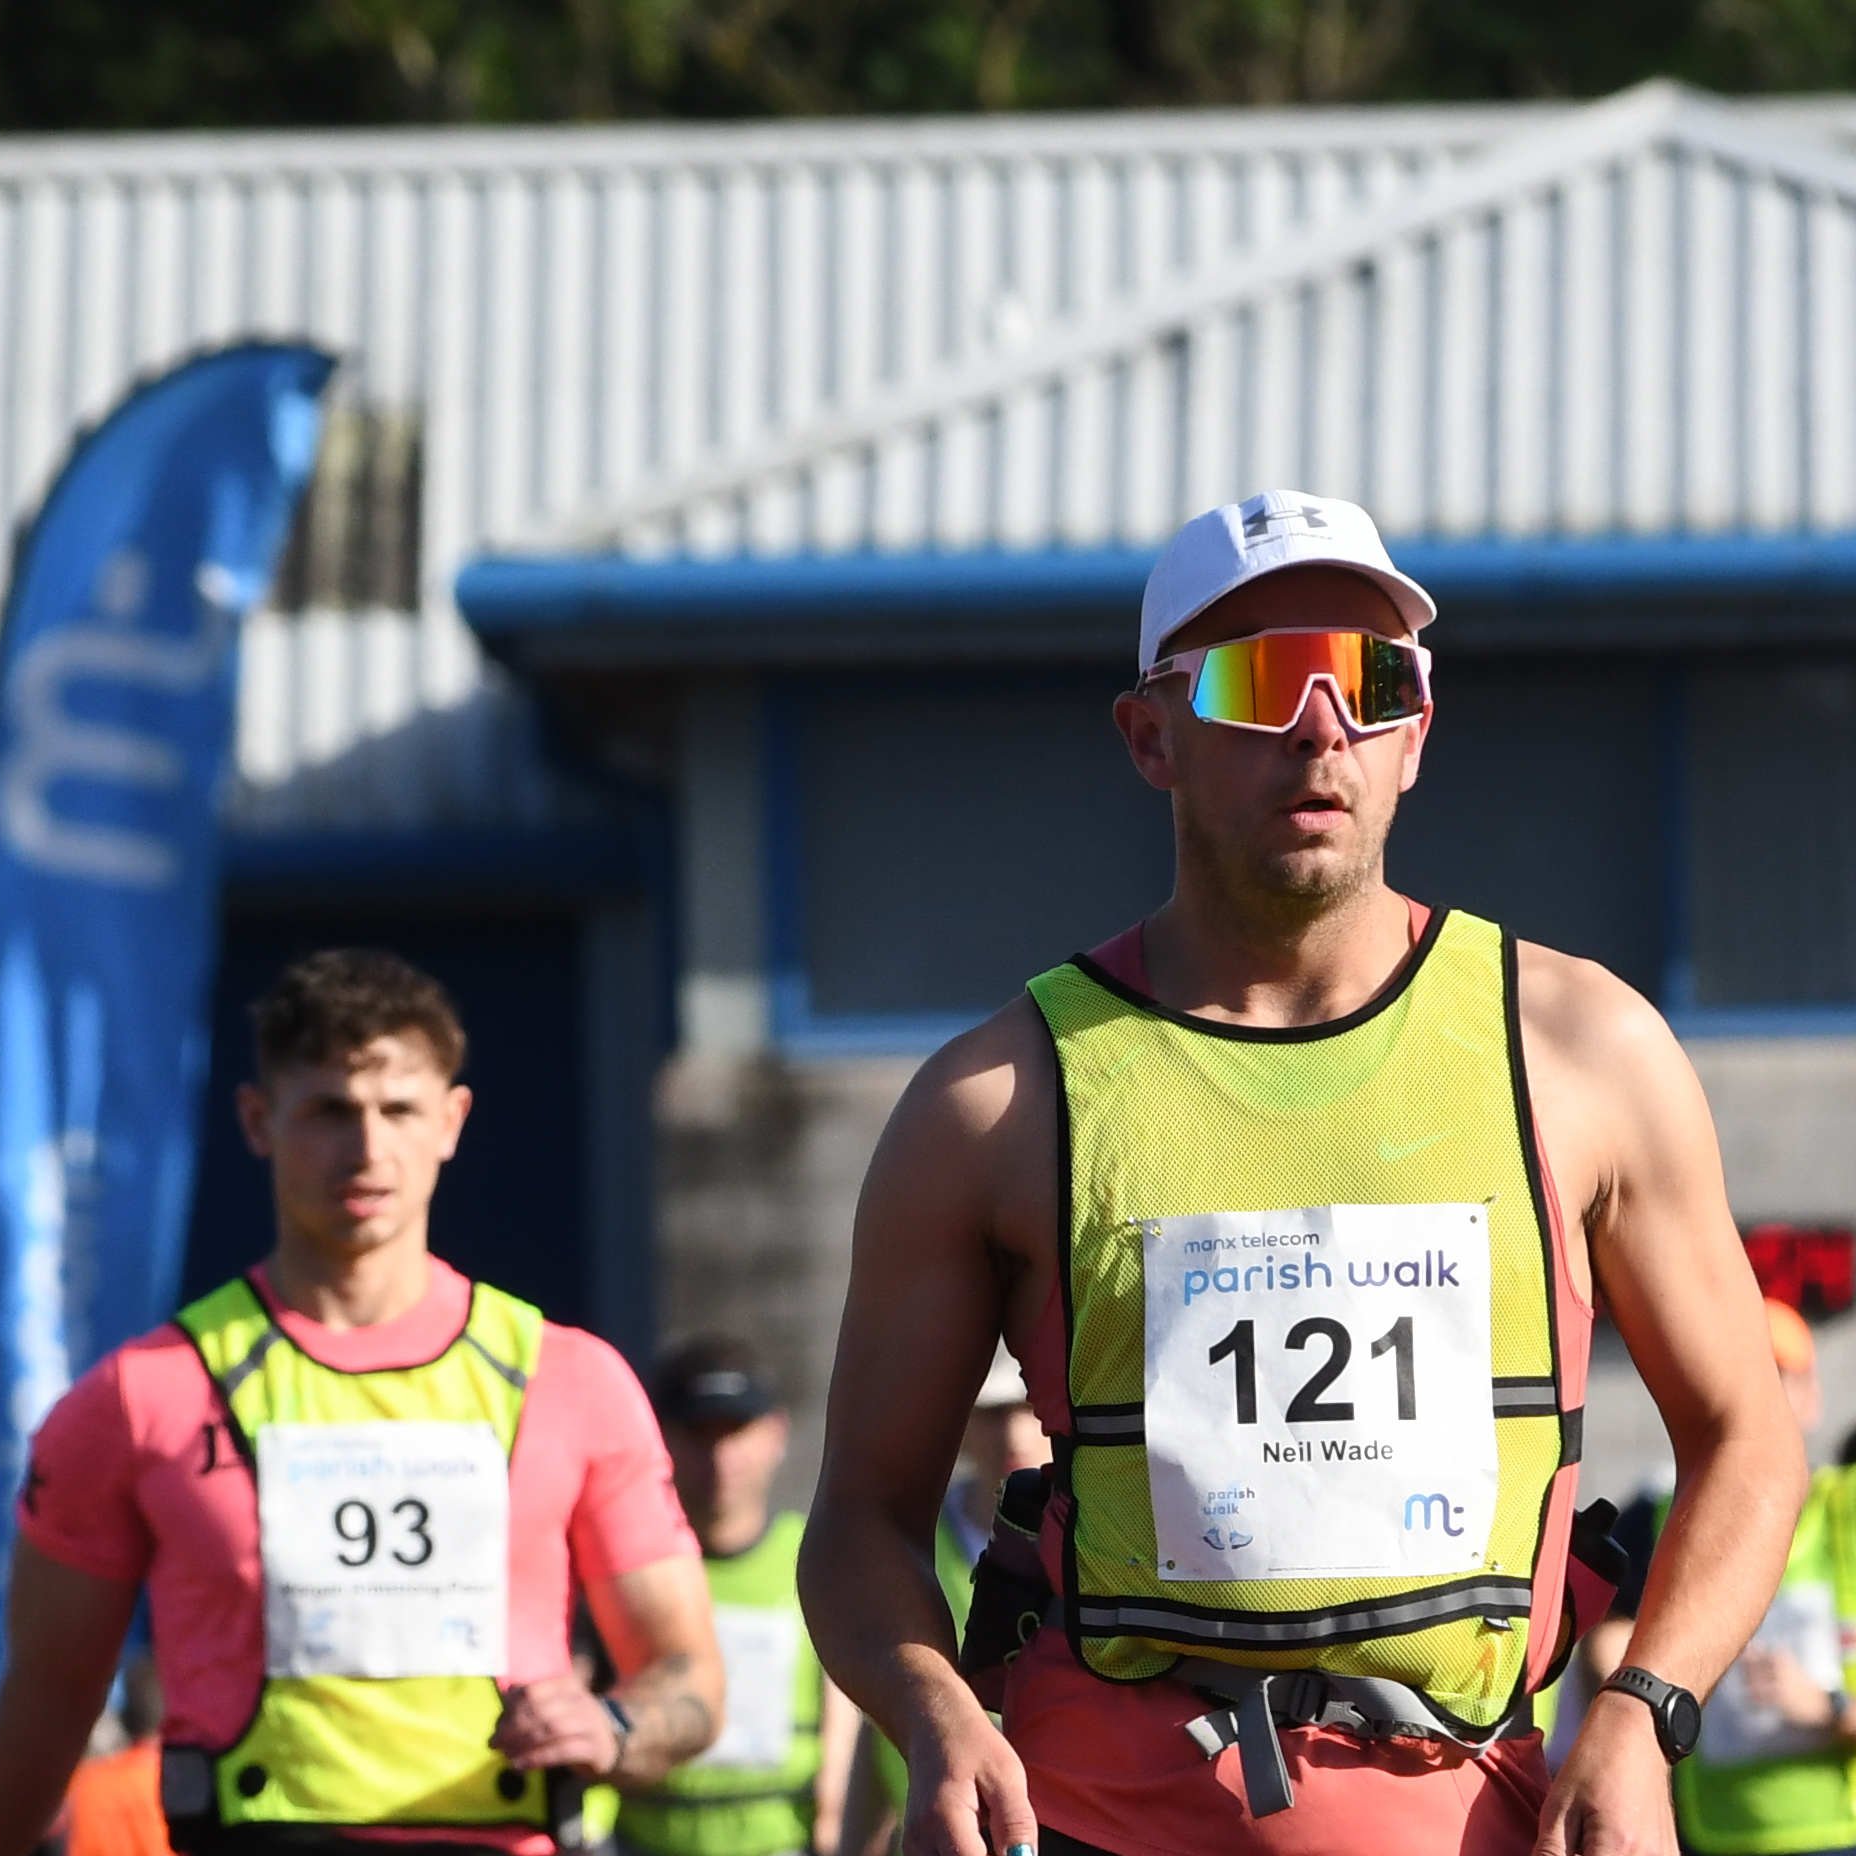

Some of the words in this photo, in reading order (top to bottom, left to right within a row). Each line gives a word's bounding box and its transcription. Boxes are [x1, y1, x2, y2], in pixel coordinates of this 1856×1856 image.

[1184, 1236, 1237, 1253] manx
[1241, 1231, 1320, 1249] telecom
[1184, 1252, 1331, 1306] parish
[1348, 1250, 1460, 1288] walk
[1209, 1316, 1417, 1424] 121
[1262, 1442, 1312, 1463] Neil
[1321, 1441, 1394, 1461] Wade
[1207, 1487, 1256, 1503] parish
[1204, 1503, 1240, 1515] walk
[333, 1499, 435, 1568] 93
